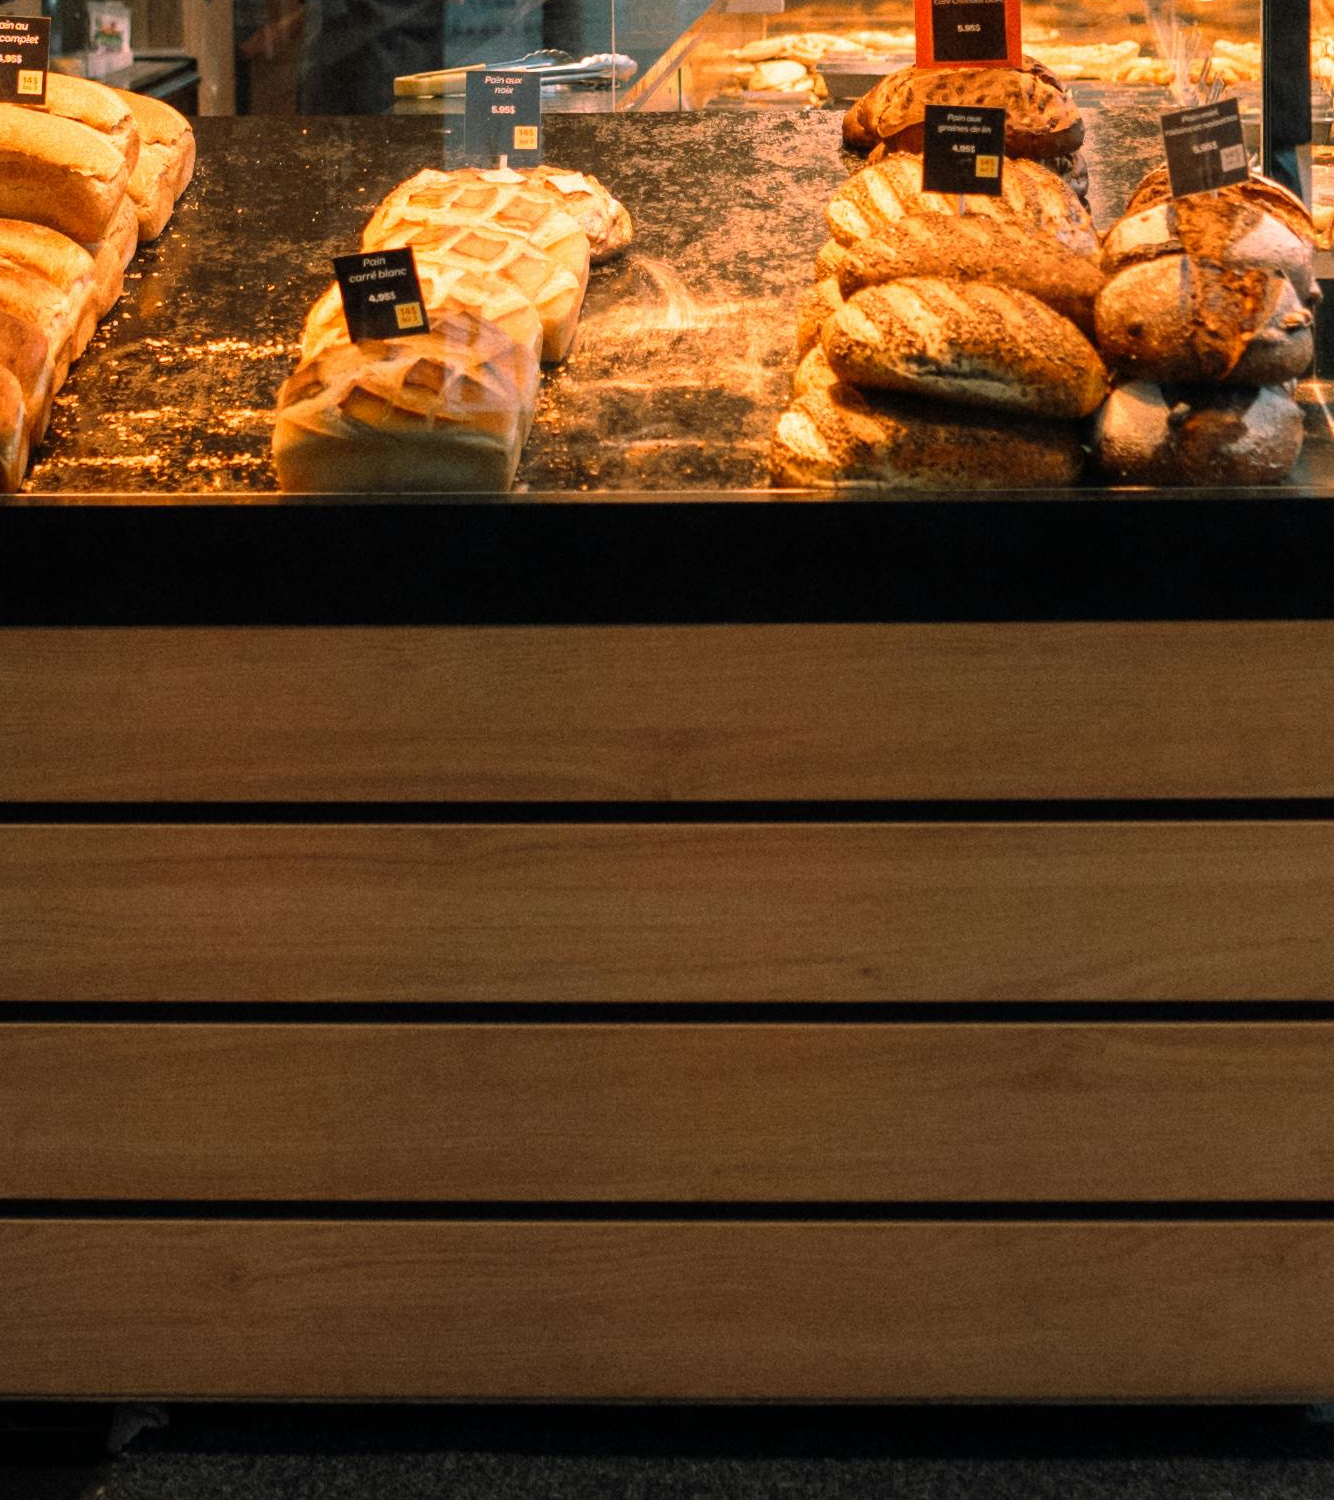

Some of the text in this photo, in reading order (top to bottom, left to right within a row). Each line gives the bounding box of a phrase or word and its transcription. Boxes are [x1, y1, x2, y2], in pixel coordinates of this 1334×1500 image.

[15, 22, 28, 30] au
[0, 34, 39, 45] complet
[484, 75, 504, 84] Pain
[363, 255, 385, 267] Pain
[349, 268, 406, 283] carré blanc
